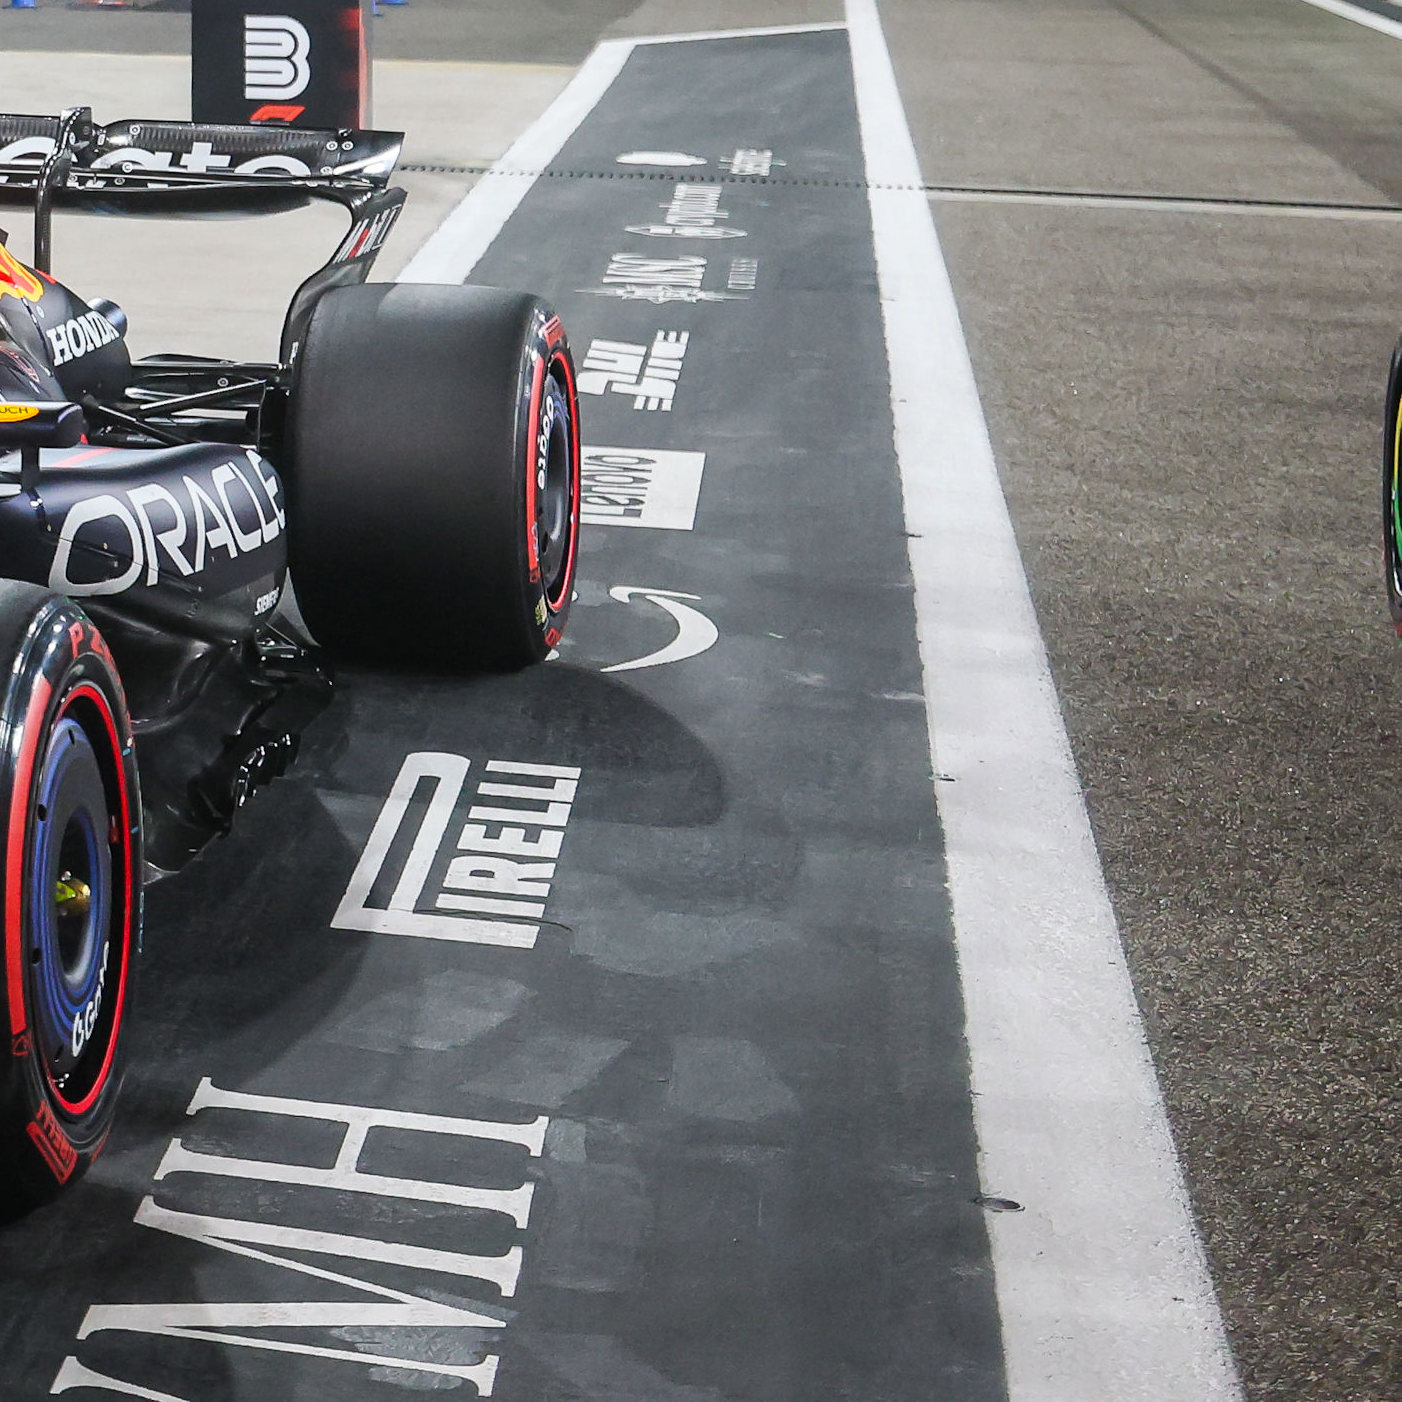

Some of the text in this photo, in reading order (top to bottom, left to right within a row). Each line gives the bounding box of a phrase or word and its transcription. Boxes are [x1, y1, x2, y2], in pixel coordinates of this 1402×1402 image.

[47, 310, 119, 367] HONDA
[48, 448, 286, 597] ORACLE
[330, 751, 582, 949] PIRELLI
[49, 1075, 550, 1402] MH
